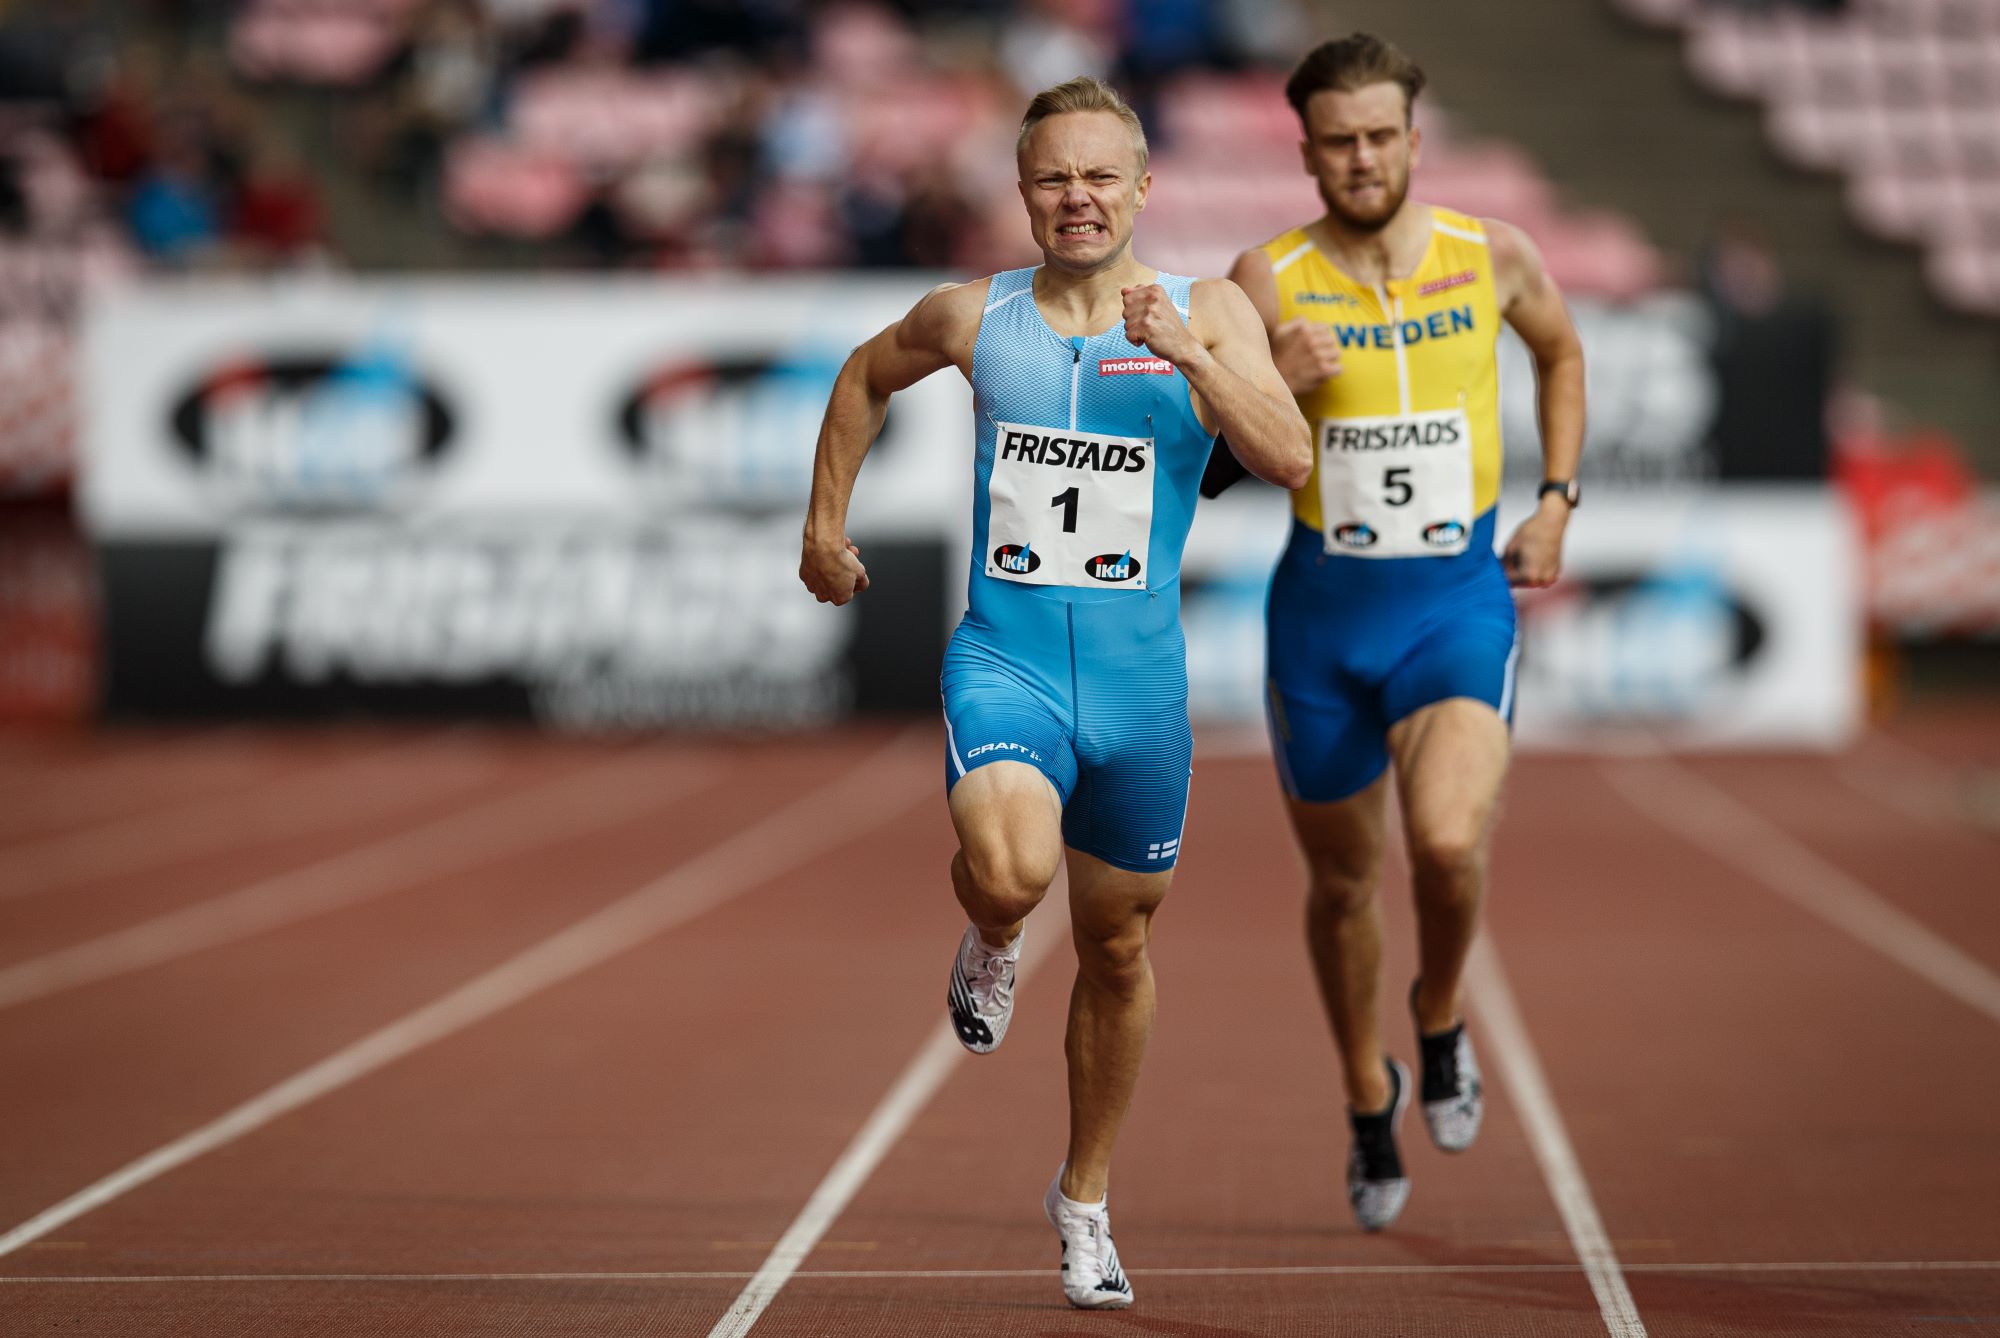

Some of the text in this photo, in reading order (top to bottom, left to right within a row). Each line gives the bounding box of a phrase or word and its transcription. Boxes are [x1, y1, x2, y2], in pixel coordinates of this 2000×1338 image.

[1334, 303, 1474, 350] WEDEN
[1102, 360, 1171, 373] motonet
[1001, 431, 1146, 473] FRISTADS
[1326, 418, 1459, 451] FRISTADS
[1383, 467, 1414, 507] 5
[1051, 486, 1080, 534] 1
[967, 742, 1029, 758] CRAFT
